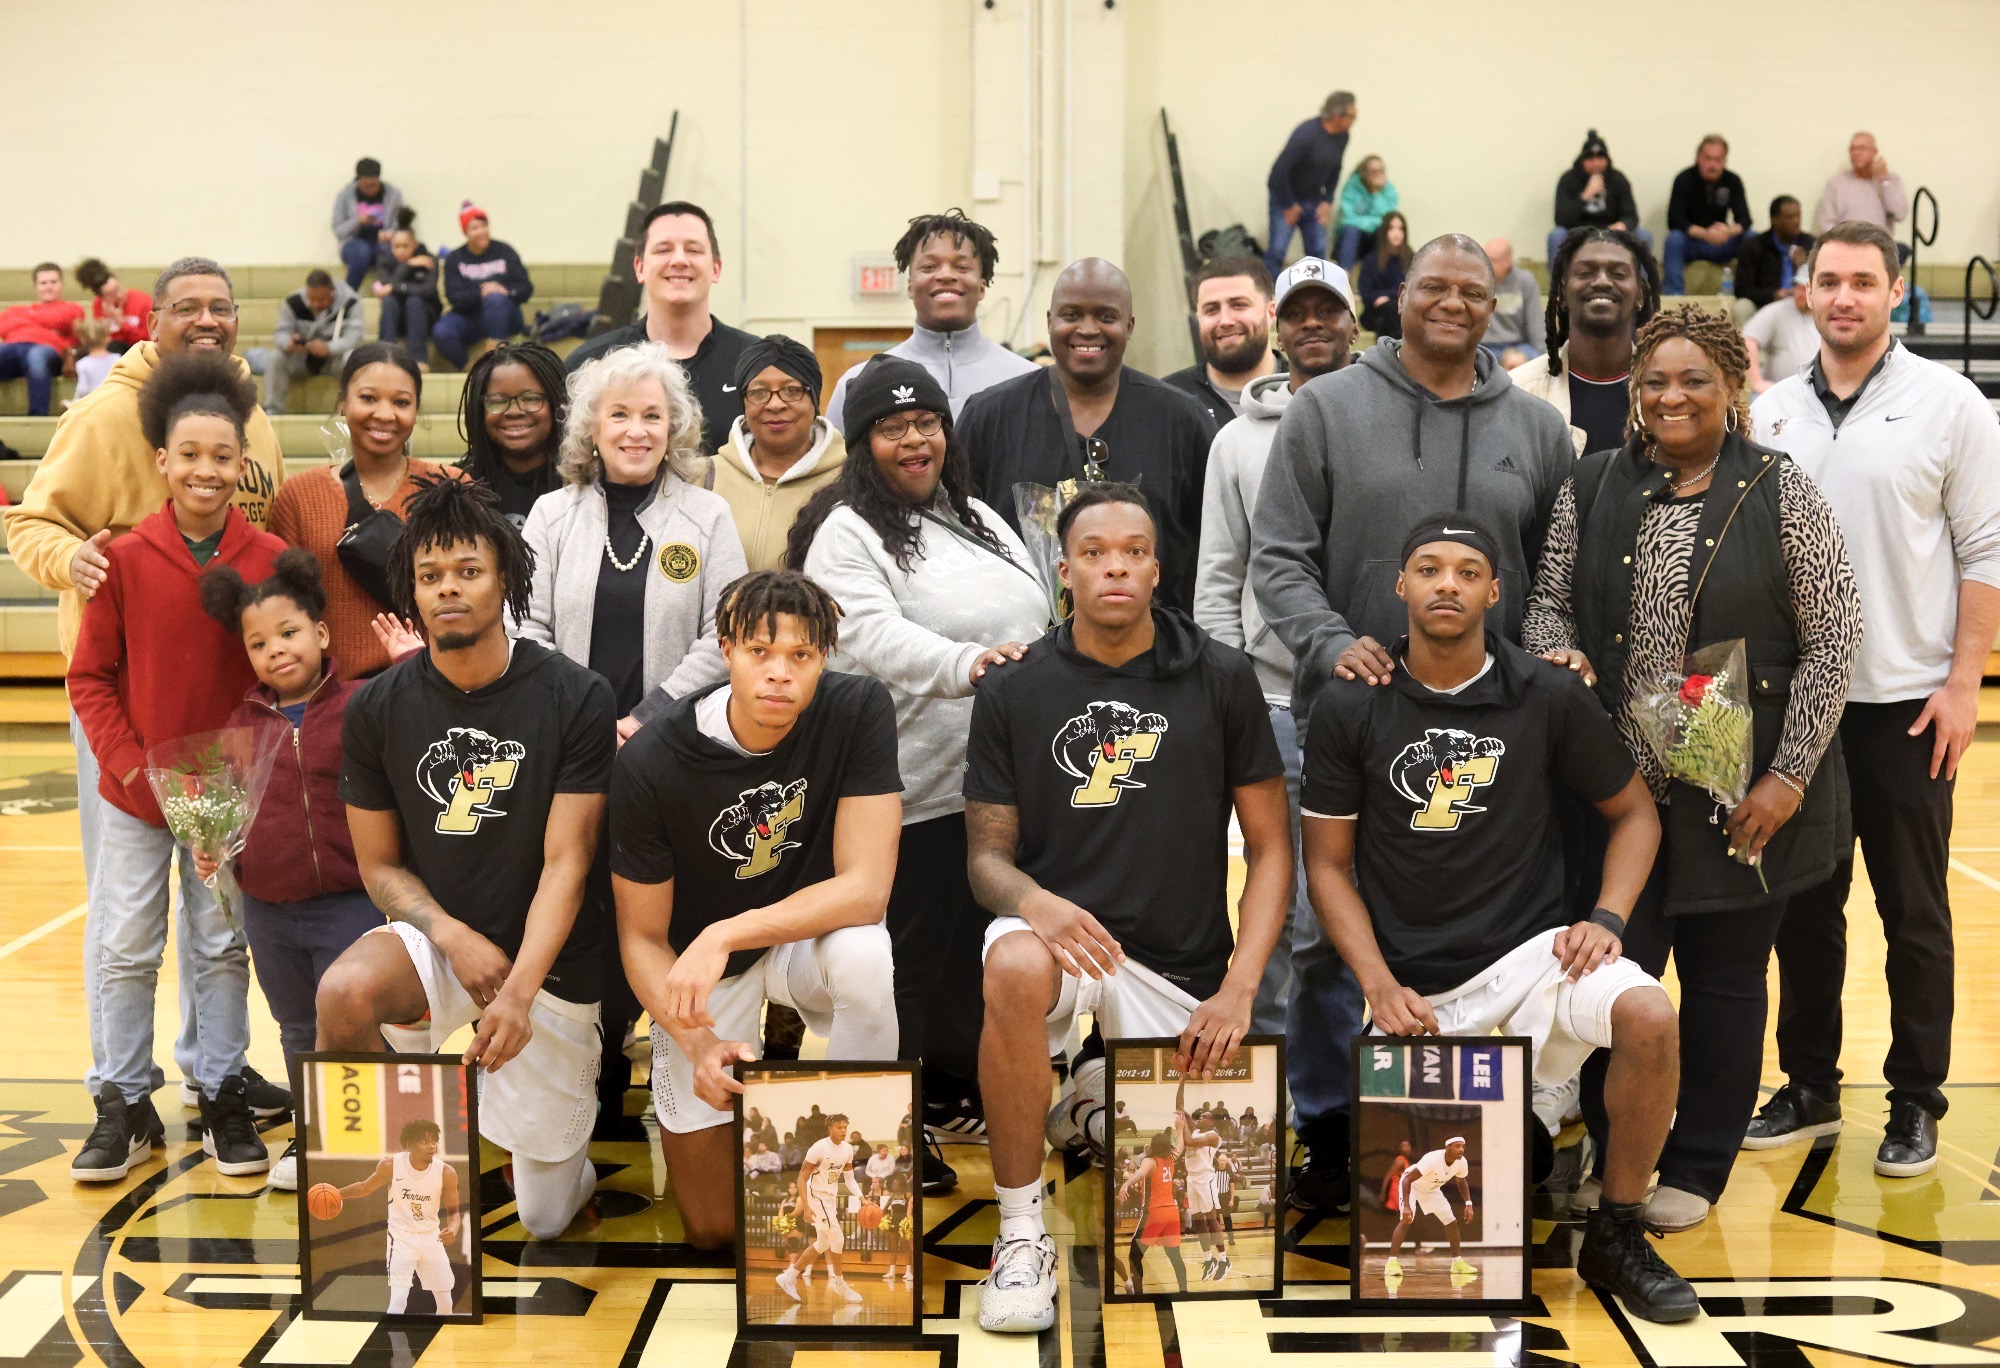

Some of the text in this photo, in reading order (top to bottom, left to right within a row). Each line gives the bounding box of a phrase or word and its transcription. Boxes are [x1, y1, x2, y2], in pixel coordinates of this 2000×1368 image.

[861, 266, 896, 291] EXIT
[1116, 1069, 1151, 1078] 2012-13
[1215, 1068, 1247, 1077] 2016-17
[1473, 1053, 1491, 1088] LEE
[342, 1065, 362, 1132] ACON
[401, 1188, 432, 1202] Ferrum
[411, 1202, 424, 1221] 5
